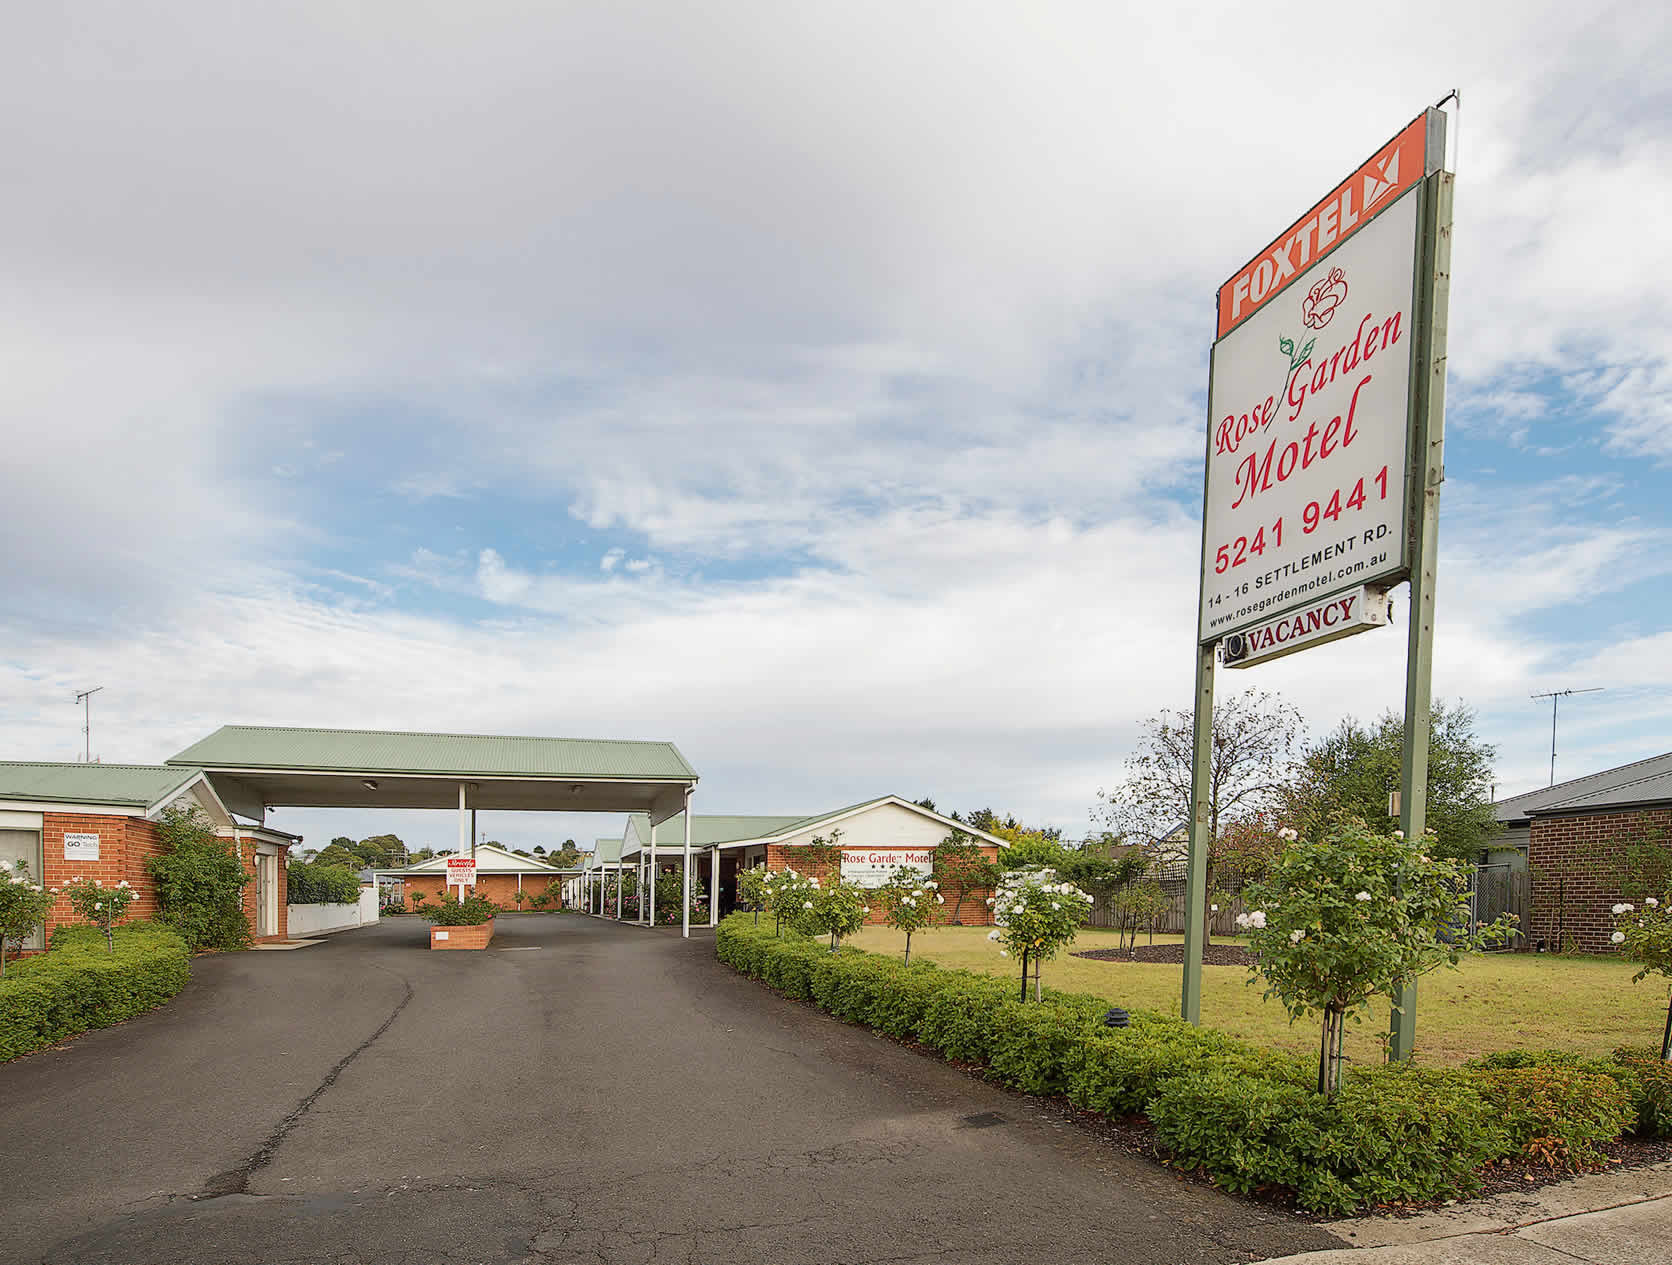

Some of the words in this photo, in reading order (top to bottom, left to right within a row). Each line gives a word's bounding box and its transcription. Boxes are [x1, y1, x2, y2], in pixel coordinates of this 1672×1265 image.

[1231, 186, 1359, 321] FOXTEL
[1216, 396, 1274, 457] Rose
[1288, 311, 1402, 422] Garden
[1231, 375, 1372, 510] Motel
[1207, 593, 1221, 609] 14
[1234, 582, 1249, 599] 16
[1255, 535, 1357, 590] SETTLEMENT
[1363, 523, 1392, 545] RD.
[1215, 517, 1284, 575] 5241
[1302, 465, 1388, 535] 9441
[1209, 551, 1387, 629] www.rosegardenmotel.com.au
[1247, 595, 1357, 652] VACANCY
[843, 852, 866, 864] Rose
